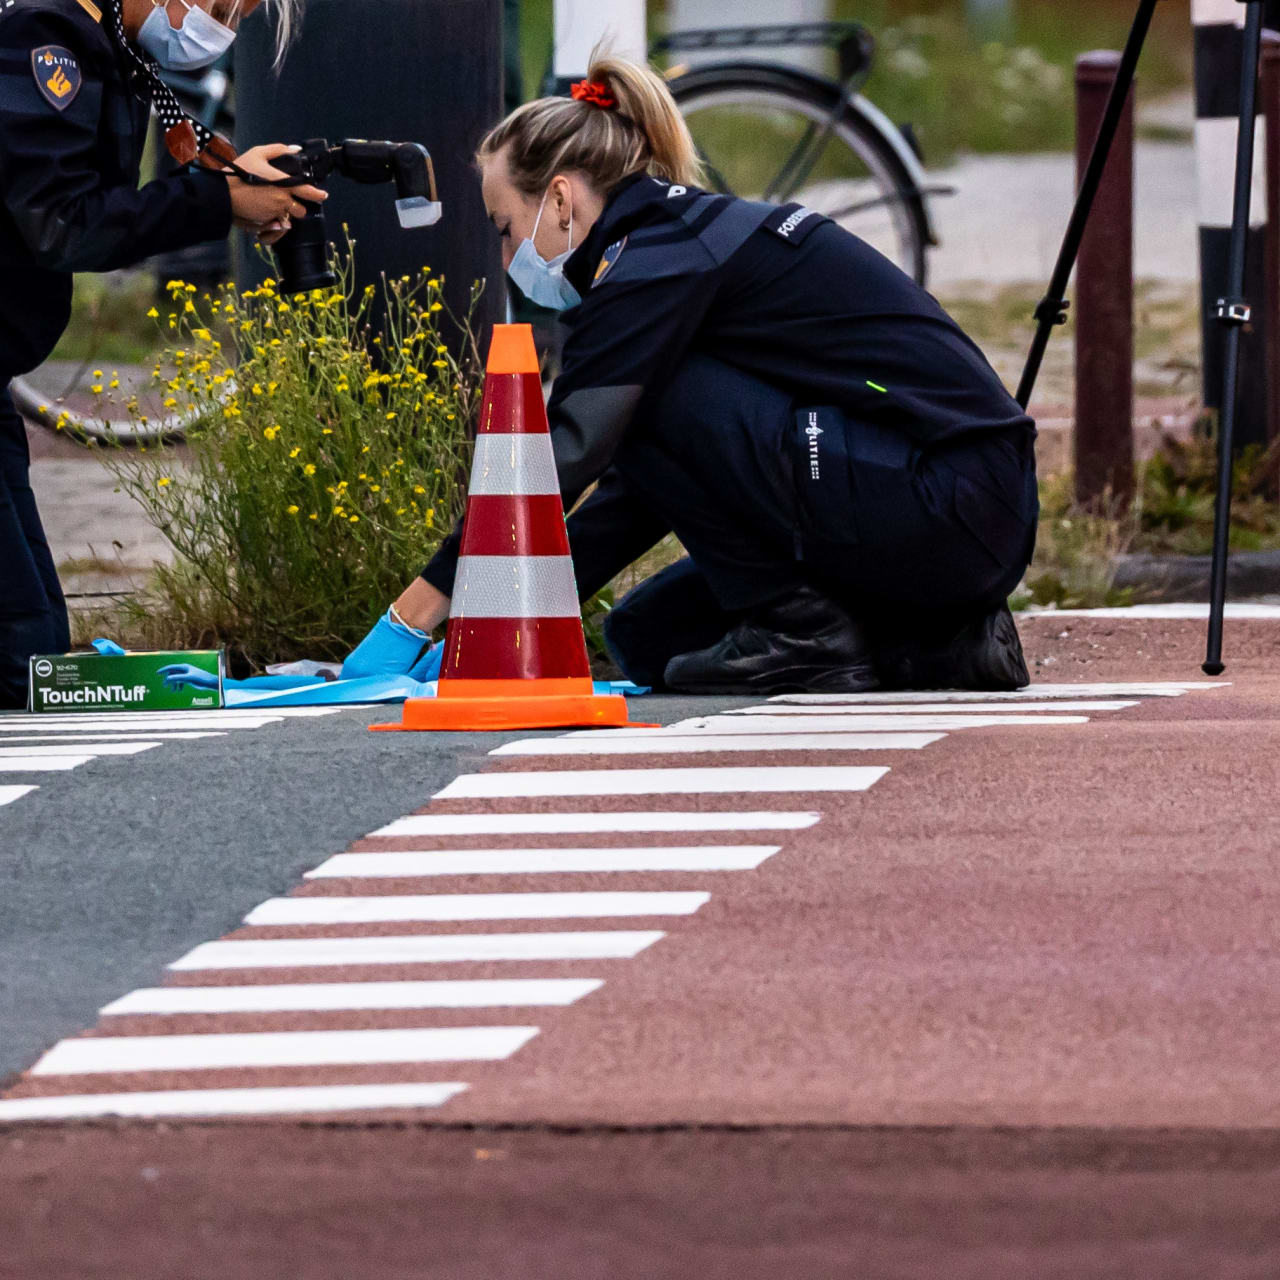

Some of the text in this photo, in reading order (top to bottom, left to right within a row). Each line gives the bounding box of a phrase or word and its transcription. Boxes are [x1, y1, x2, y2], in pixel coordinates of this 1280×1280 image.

[38, 53, 77, 69] POLITIE
[805, 421, 821, 467] POLITIE
[38, 685, 147, 705] TouchNTuff
